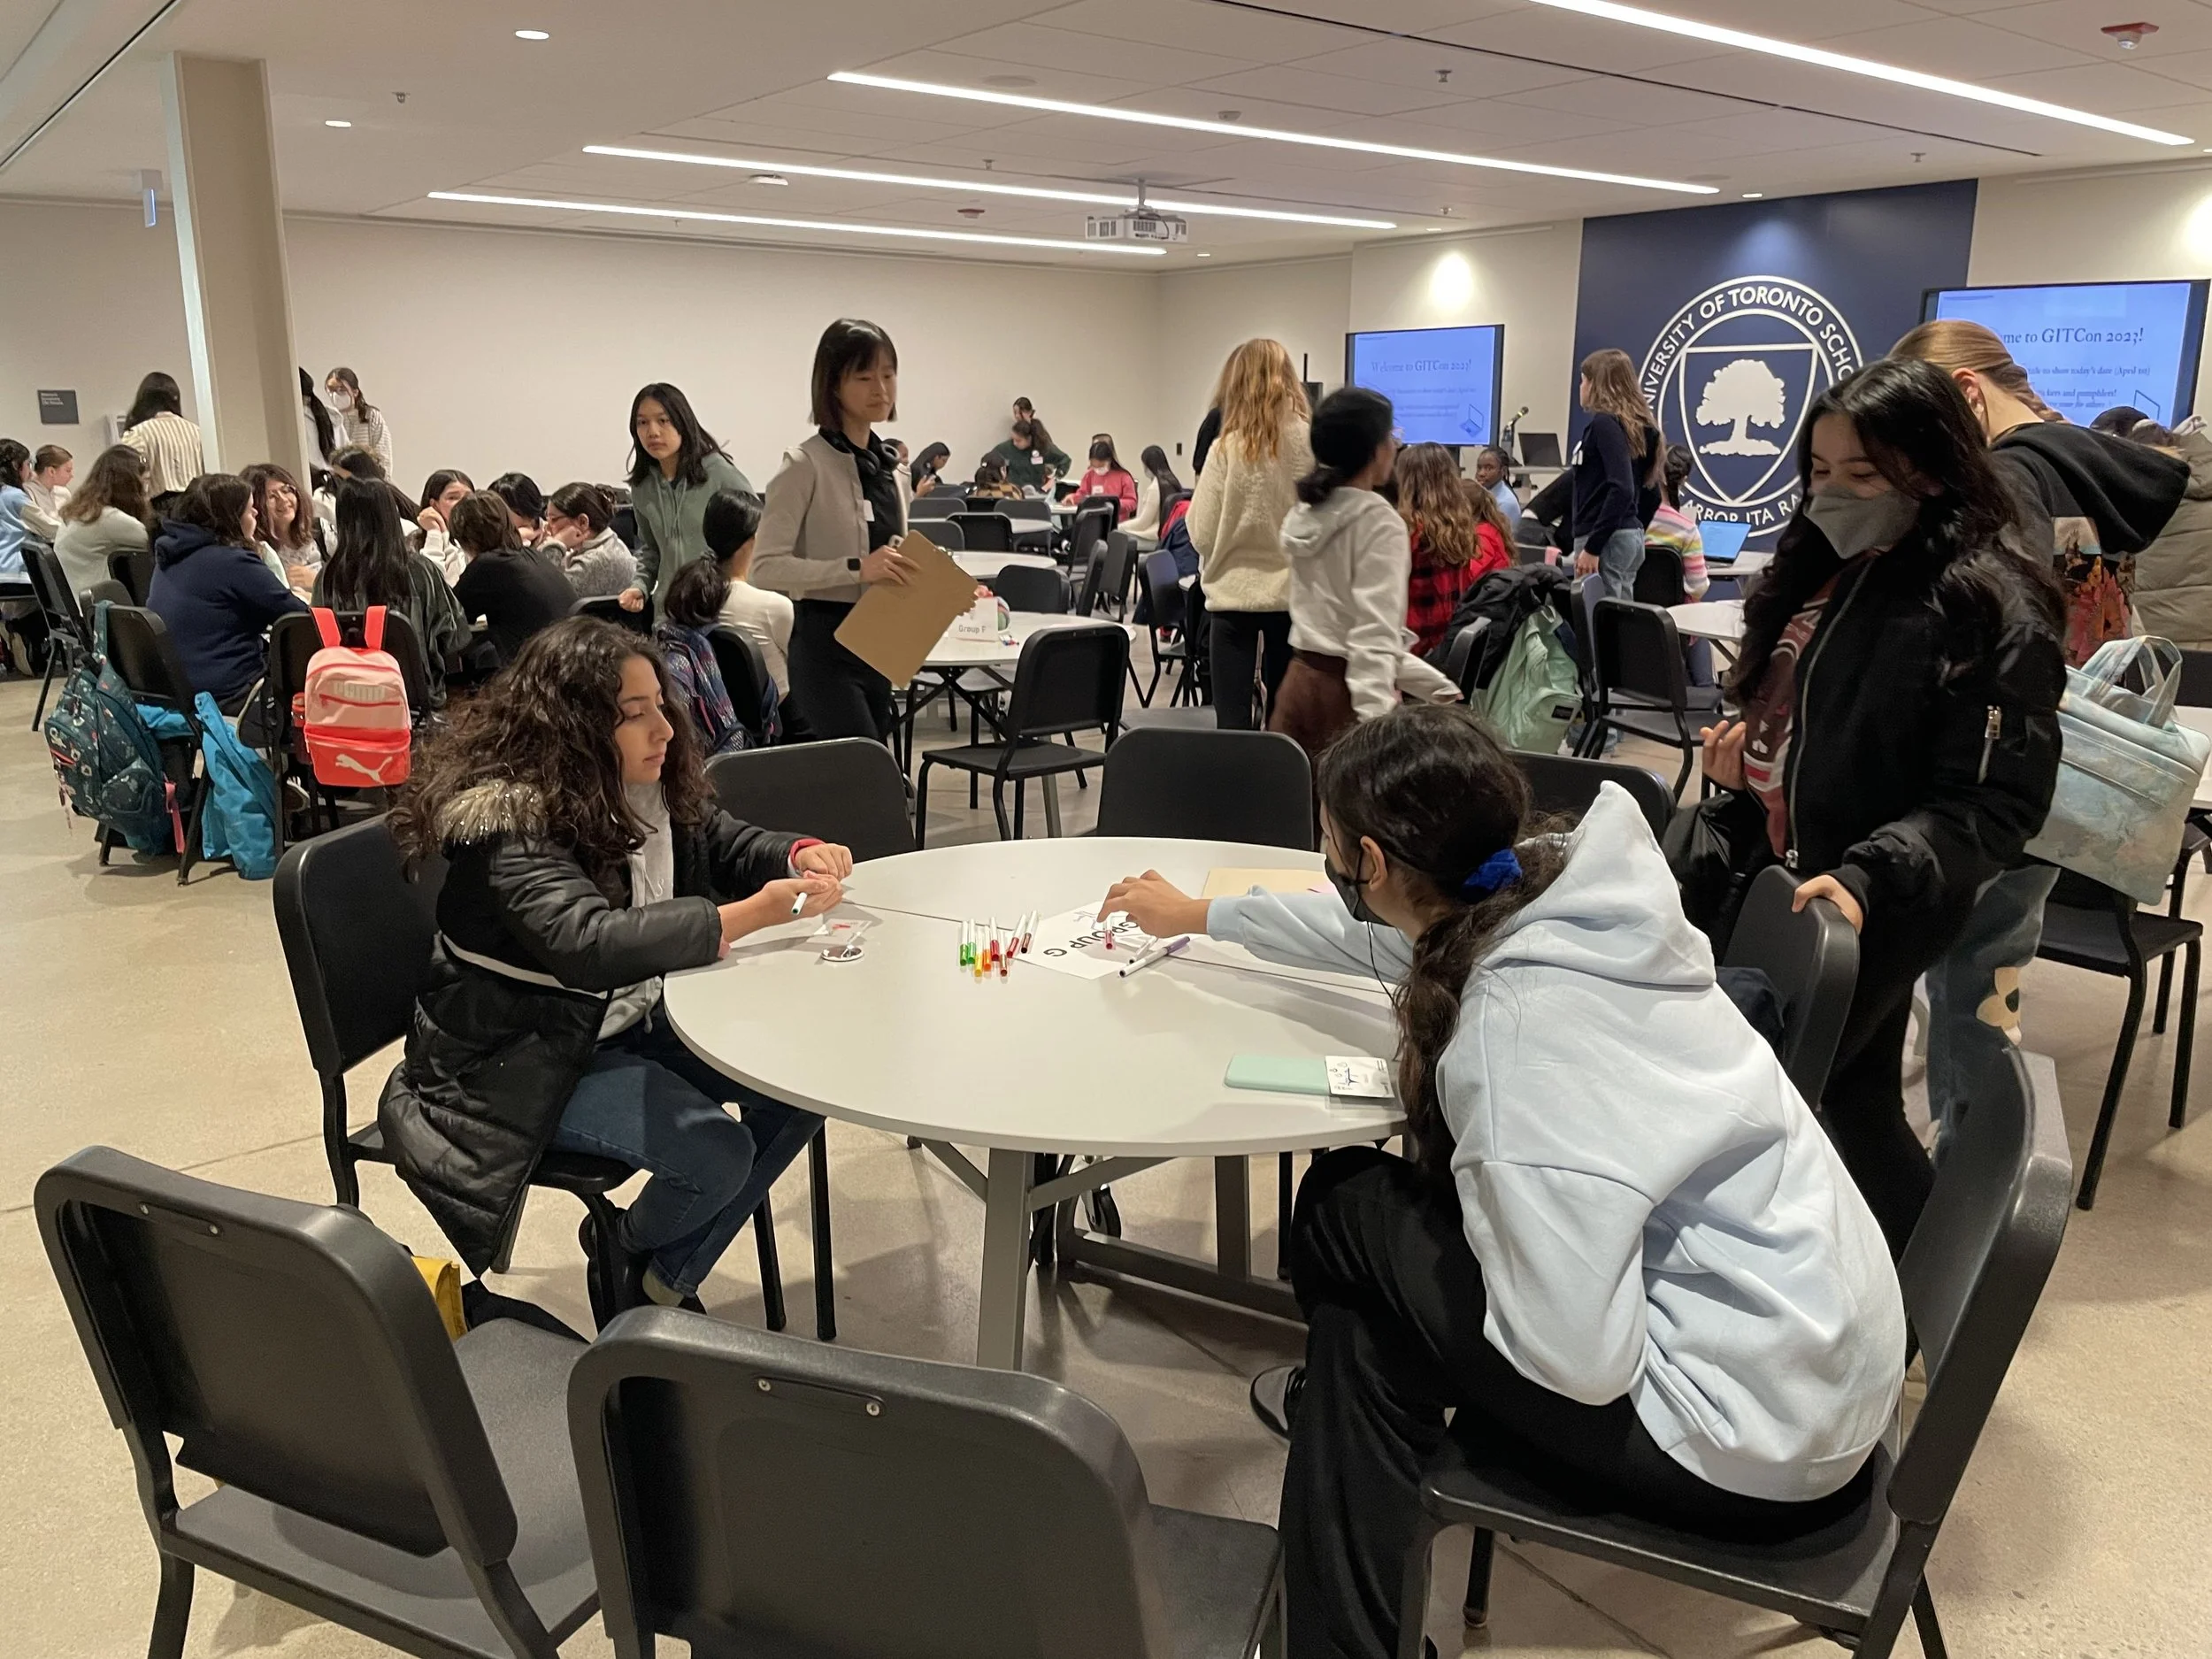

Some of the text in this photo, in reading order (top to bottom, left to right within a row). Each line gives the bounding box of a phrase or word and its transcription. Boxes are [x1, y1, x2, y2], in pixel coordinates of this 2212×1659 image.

[2025, 332, 2038, 344] to
[2041, 327, 2102, 343] GITCon
[2106, 327, 2144, 346] 2023!
[1642, 286, 1855, 410] NIVERSITY OF TORONTO SCHO
[1746, 507, 1775, 526] ITA
[1043, 948, 1068, 956] G
